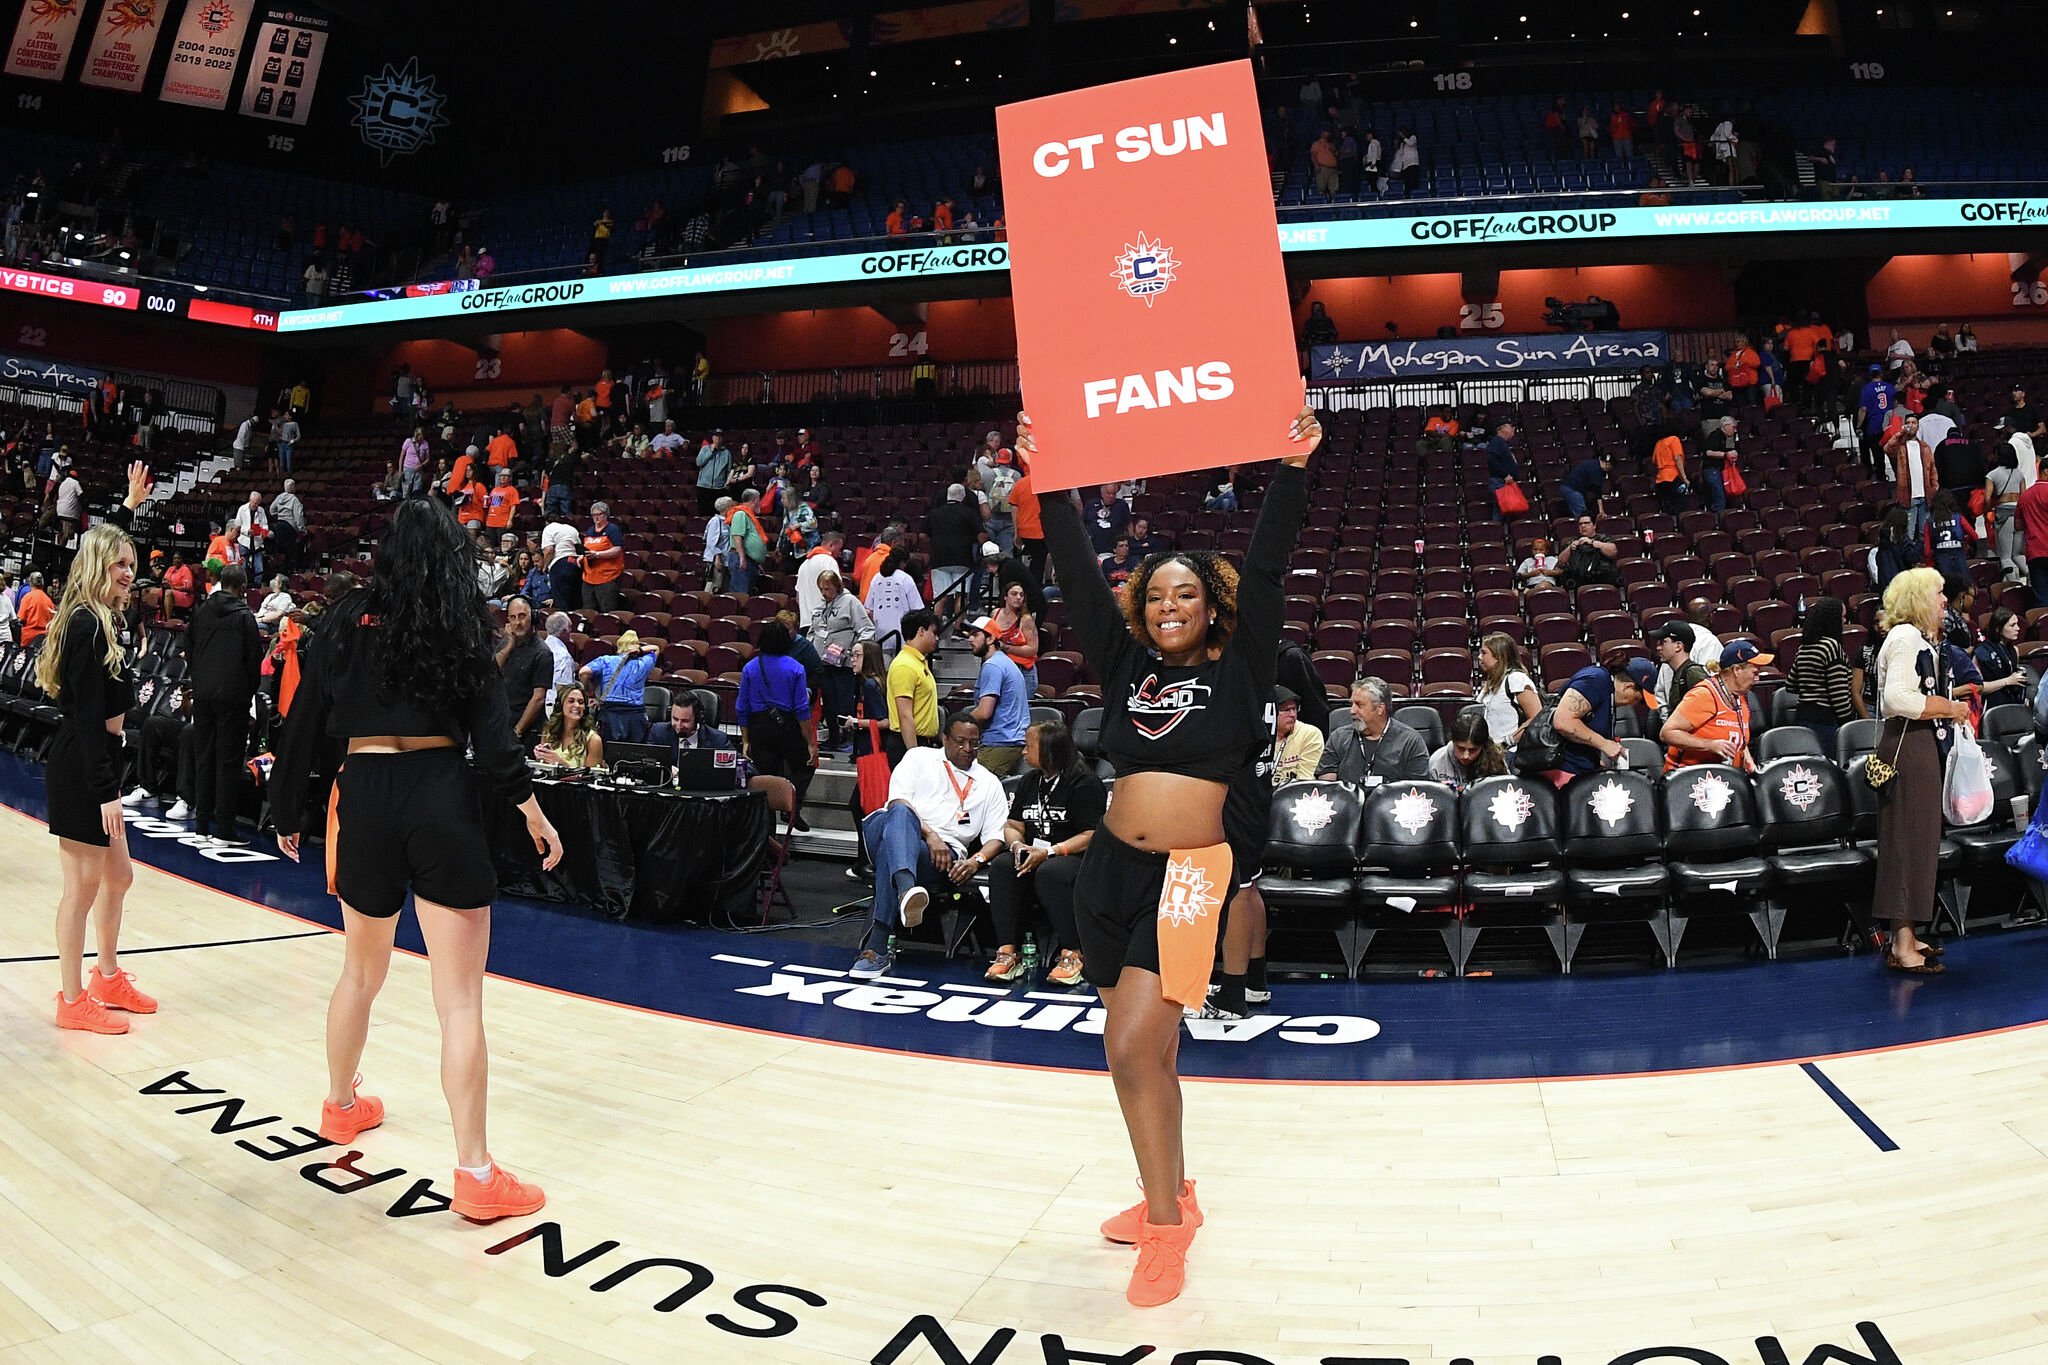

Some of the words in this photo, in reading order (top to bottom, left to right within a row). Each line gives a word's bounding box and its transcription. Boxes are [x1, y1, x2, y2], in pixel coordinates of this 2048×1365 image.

[267, 10, 285, 20] SUN
[294, 15, 329, 27] LEGENDS
[26, 39, 59, 51] EASTERN
[36, 31, 54, 41] 2004
[275, 31, 287, 42] 12
[298, 36, 311, 46] 42
[16, 47, 62, 62] CONFERENCE
[103, 49, 137, 63] EASTERN
[177, 40, 205, 53] 2004
[208, 45, 236, 58] 2005
[15, 57, 58, 71] CHAMPIONS
[93, 57, 141, 73] CONFERENCE
[174, 53, 202, 66] 2019
[204, 58, 232, 71] 2022
[266, 60, 279, 71] 23
[290, 64, 302, 75] 13
[1848, 61, 1886, 80] 119
[91, 67, 136, 82] CHAMPIONS
[1432, 72, 1473, 91] 118
[18, 94, 43, 111] 114
[259, 91, 270, 102] 15
[267, 134, 295, 152] 115
[1033, 133, 1104, 177] CT
[1115, 112, 1229, 163] SUN
[662, 145, 691, 163] 116
[1654, 206, 1891, 228] WWW.GOFFLAWGROUP.NET
[0, 270, 74, 296] YSTICS
[609, 265, 796, 293] WWW.GOFFLAWGROUP.NET
[102, 288, 127, 306] 90
[2011, 280, 2048, 306] 26
[147, 295, 176, 313] 00.0
[252, 313, 275, 327] 4TH
[1459, 302, 1505, 329] 25
[17, 325, 48, 347] 22
[888, 331, 929, 357] 24
[1357, 341, 1489, 376] Mohegan
[1494, 340, 1557, 369] Sun
[1561, 335, 1661, 367] Arena
[2, 358, 38, 379] Sun
[41, 364, 98, 389] Arena
[474, 357, 501, 380] 23
[1084, 361, 1235, 419] FANS
[1877, 393, 1888, 410] 3
[811, 609, 839, 618] SN
[138, 1069, 453, 1219] ARENA
[483, 1221, 828, 1338] SUN
